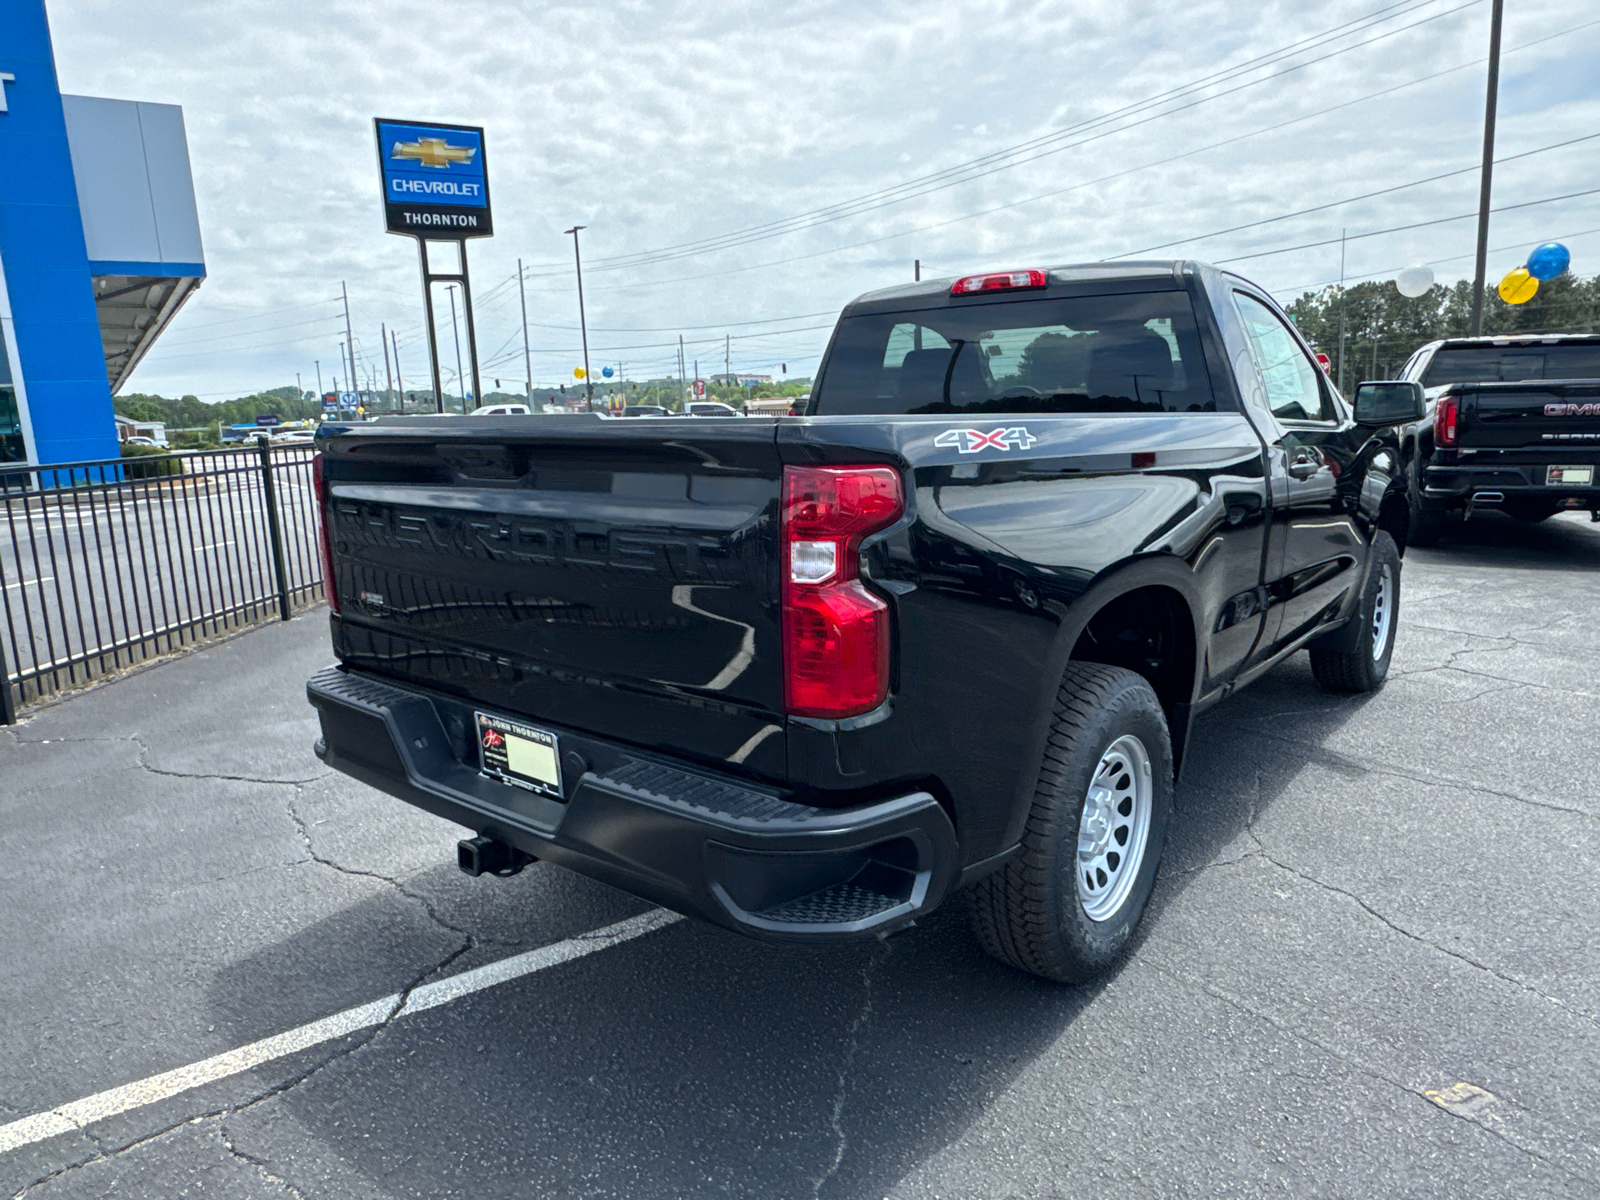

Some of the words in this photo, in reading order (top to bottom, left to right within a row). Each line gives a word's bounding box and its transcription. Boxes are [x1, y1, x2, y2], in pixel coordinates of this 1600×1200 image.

[392, 179, 480, 196] CHEVROLET
[403, 212, 478, 227] THORNTON
[338, 506, 734, 580] CHEVROLET
[492, 719, 511, 732] JOHN
[512, 725, 552, 744] THORNTON
